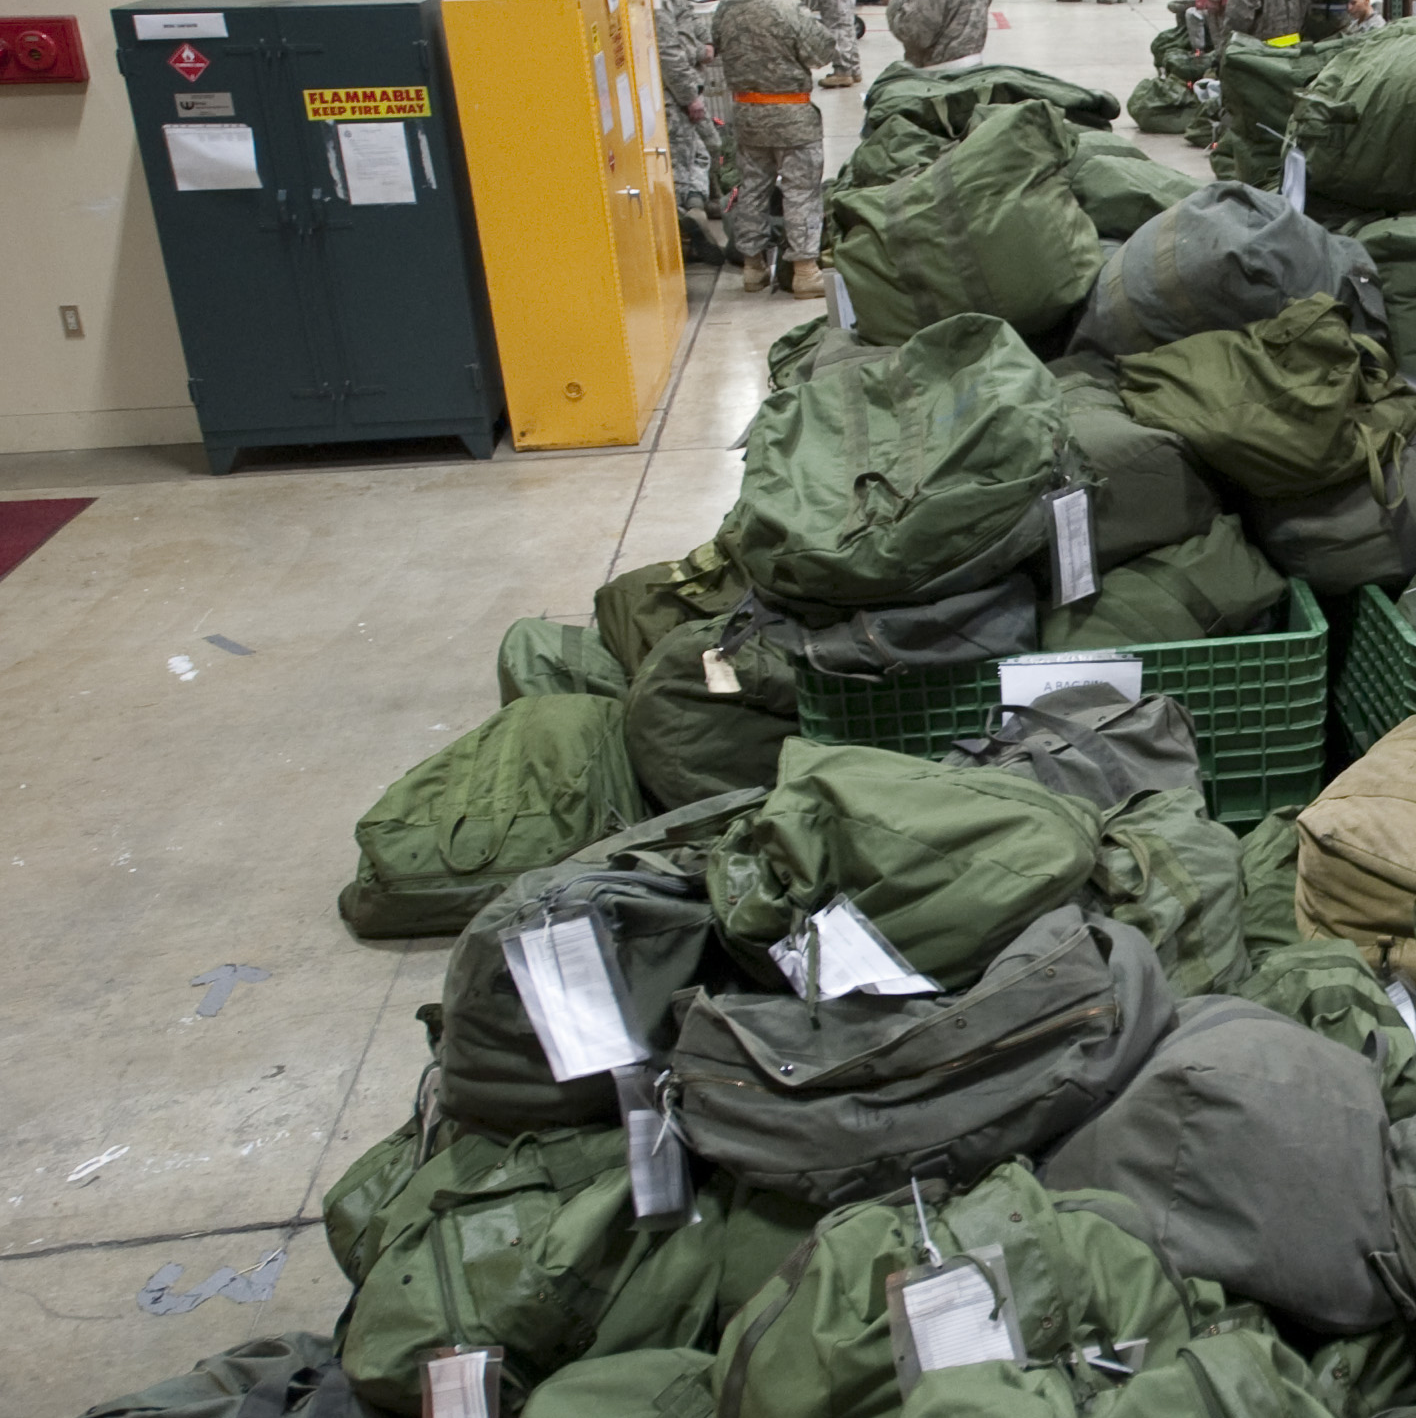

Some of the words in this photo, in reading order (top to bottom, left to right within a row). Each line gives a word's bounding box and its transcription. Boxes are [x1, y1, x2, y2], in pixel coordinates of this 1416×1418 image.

[308, 89, 425, 105] FLAMMABLE
[311, 106, 346, 117] KEEP
[350, 105, 380, 115] FIRE
[386, 103, 425, 114] AWAY
[1044, 682, 1052, 692] A
